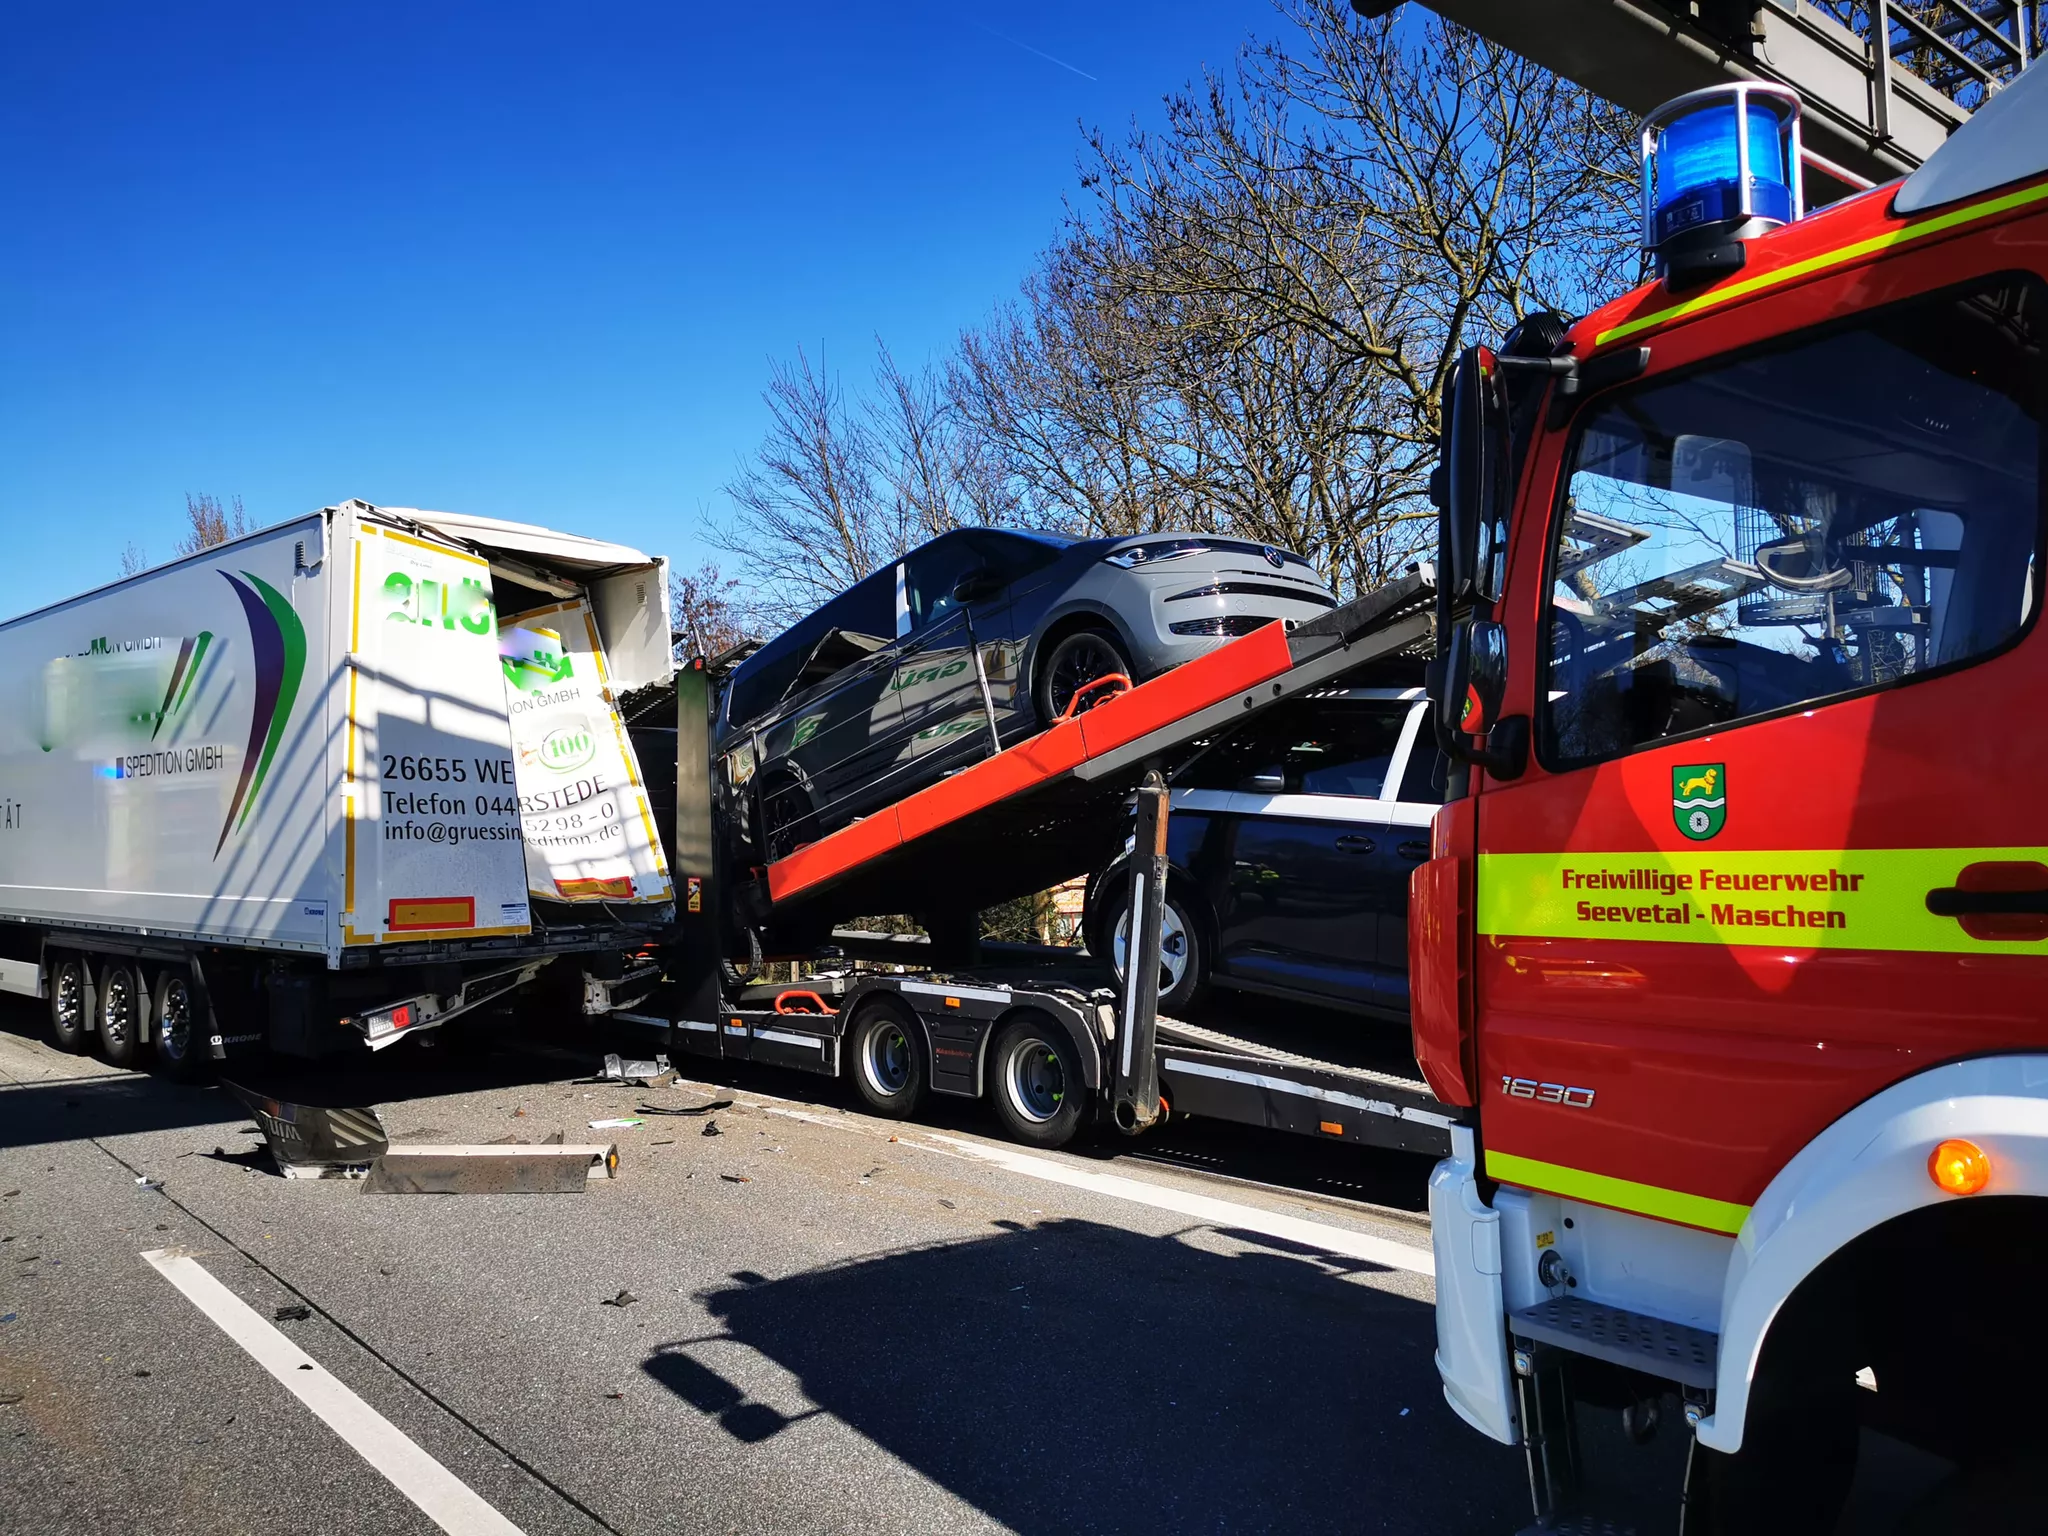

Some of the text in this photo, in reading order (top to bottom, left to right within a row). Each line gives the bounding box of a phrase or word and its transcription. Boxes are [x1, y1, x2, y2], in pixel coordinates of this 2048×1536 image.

[537, 687, 581, 708] GMBH
[548, 734, 590, 758] 100
[126, 745, 223, 778] SPEDITION GMBH
[383, 755, 514, 785] 26655 WE
[383, 791, 516, 816] Telefon 044
[518, 774, 608, 812] RSTEDE
[385, 821, 520, 845] info@gruessin
[1562, 869, 1864, 895] Freiwillige Feuerwehr
[1577, 901, 1690, 924] Seevetal
[1711, 904, 1846, 929] Maschen
[1502, 1075, 1595, 1109] 1630
